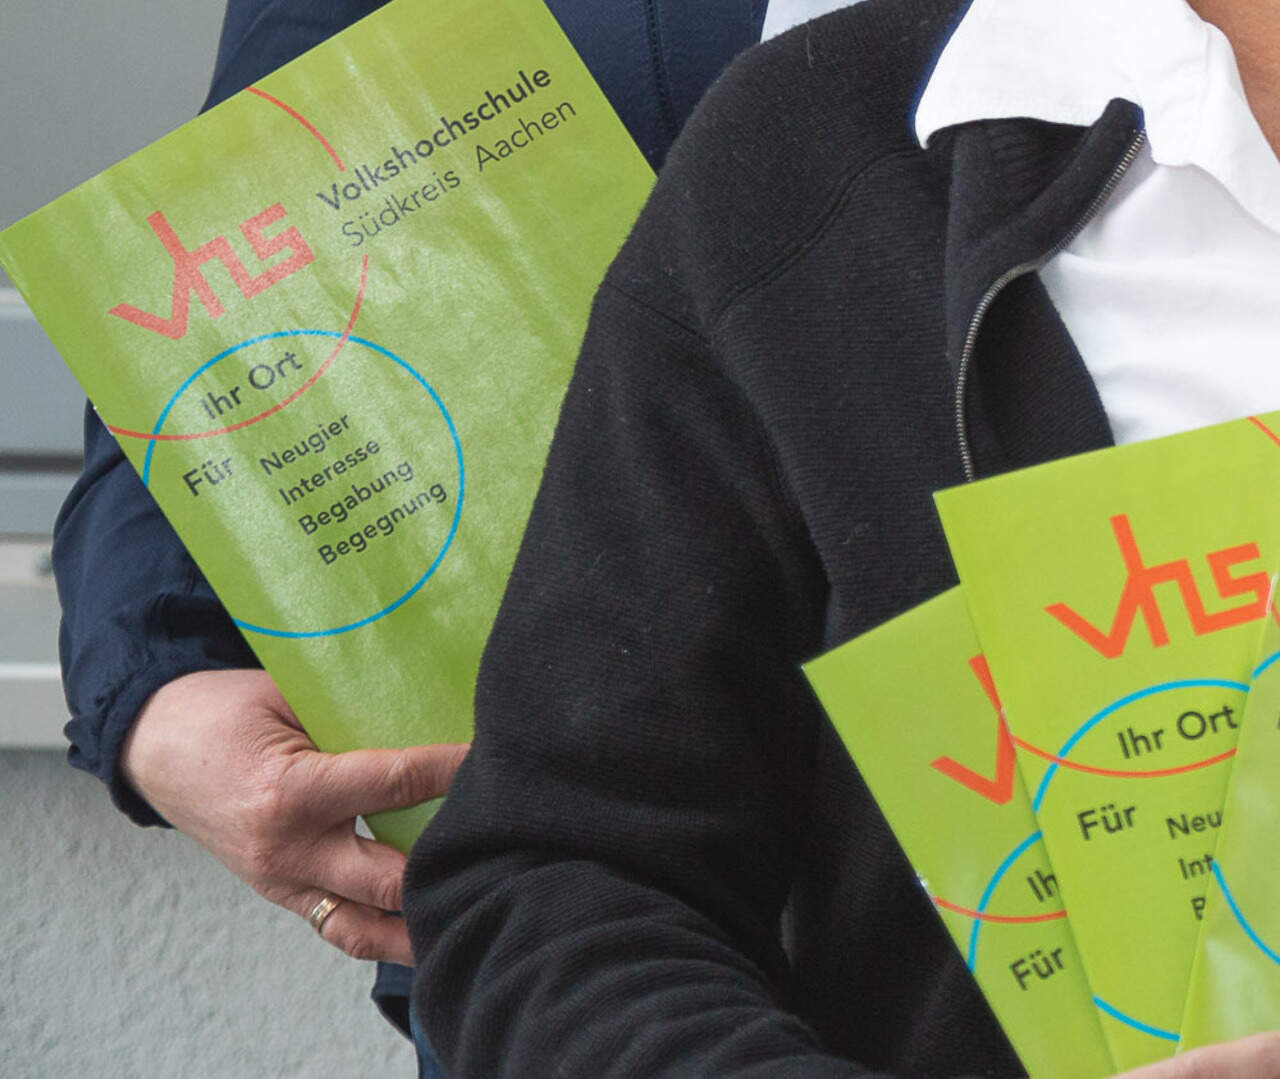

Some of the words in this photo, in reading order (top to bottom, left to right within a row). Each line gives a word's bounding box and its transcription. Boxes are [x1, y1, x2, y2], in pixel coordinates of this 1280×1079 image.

[317, 65, 552, 213] Volkshochschule
[341, 169, 461, 249] Südkreis
[473, 98, 577, 172] Aachen
[201, 380, 243, 420] Ihr
[248, 351, 304, 393] Ort
[181, 453, 235, 497] Für
[258, 414, 352, 476] Neugier
[278, 437, 380, 506] Interesse
[298, 459, 415, 537] Begabung
[317, 480, 448, 566] Begegnung
[1117, 724, 1165, 760] Ihr
[1176, 705, 1239, 741] Ort
[1077, 802, 1138, 841] Für
[1009, 947, 1065, 991] Für
